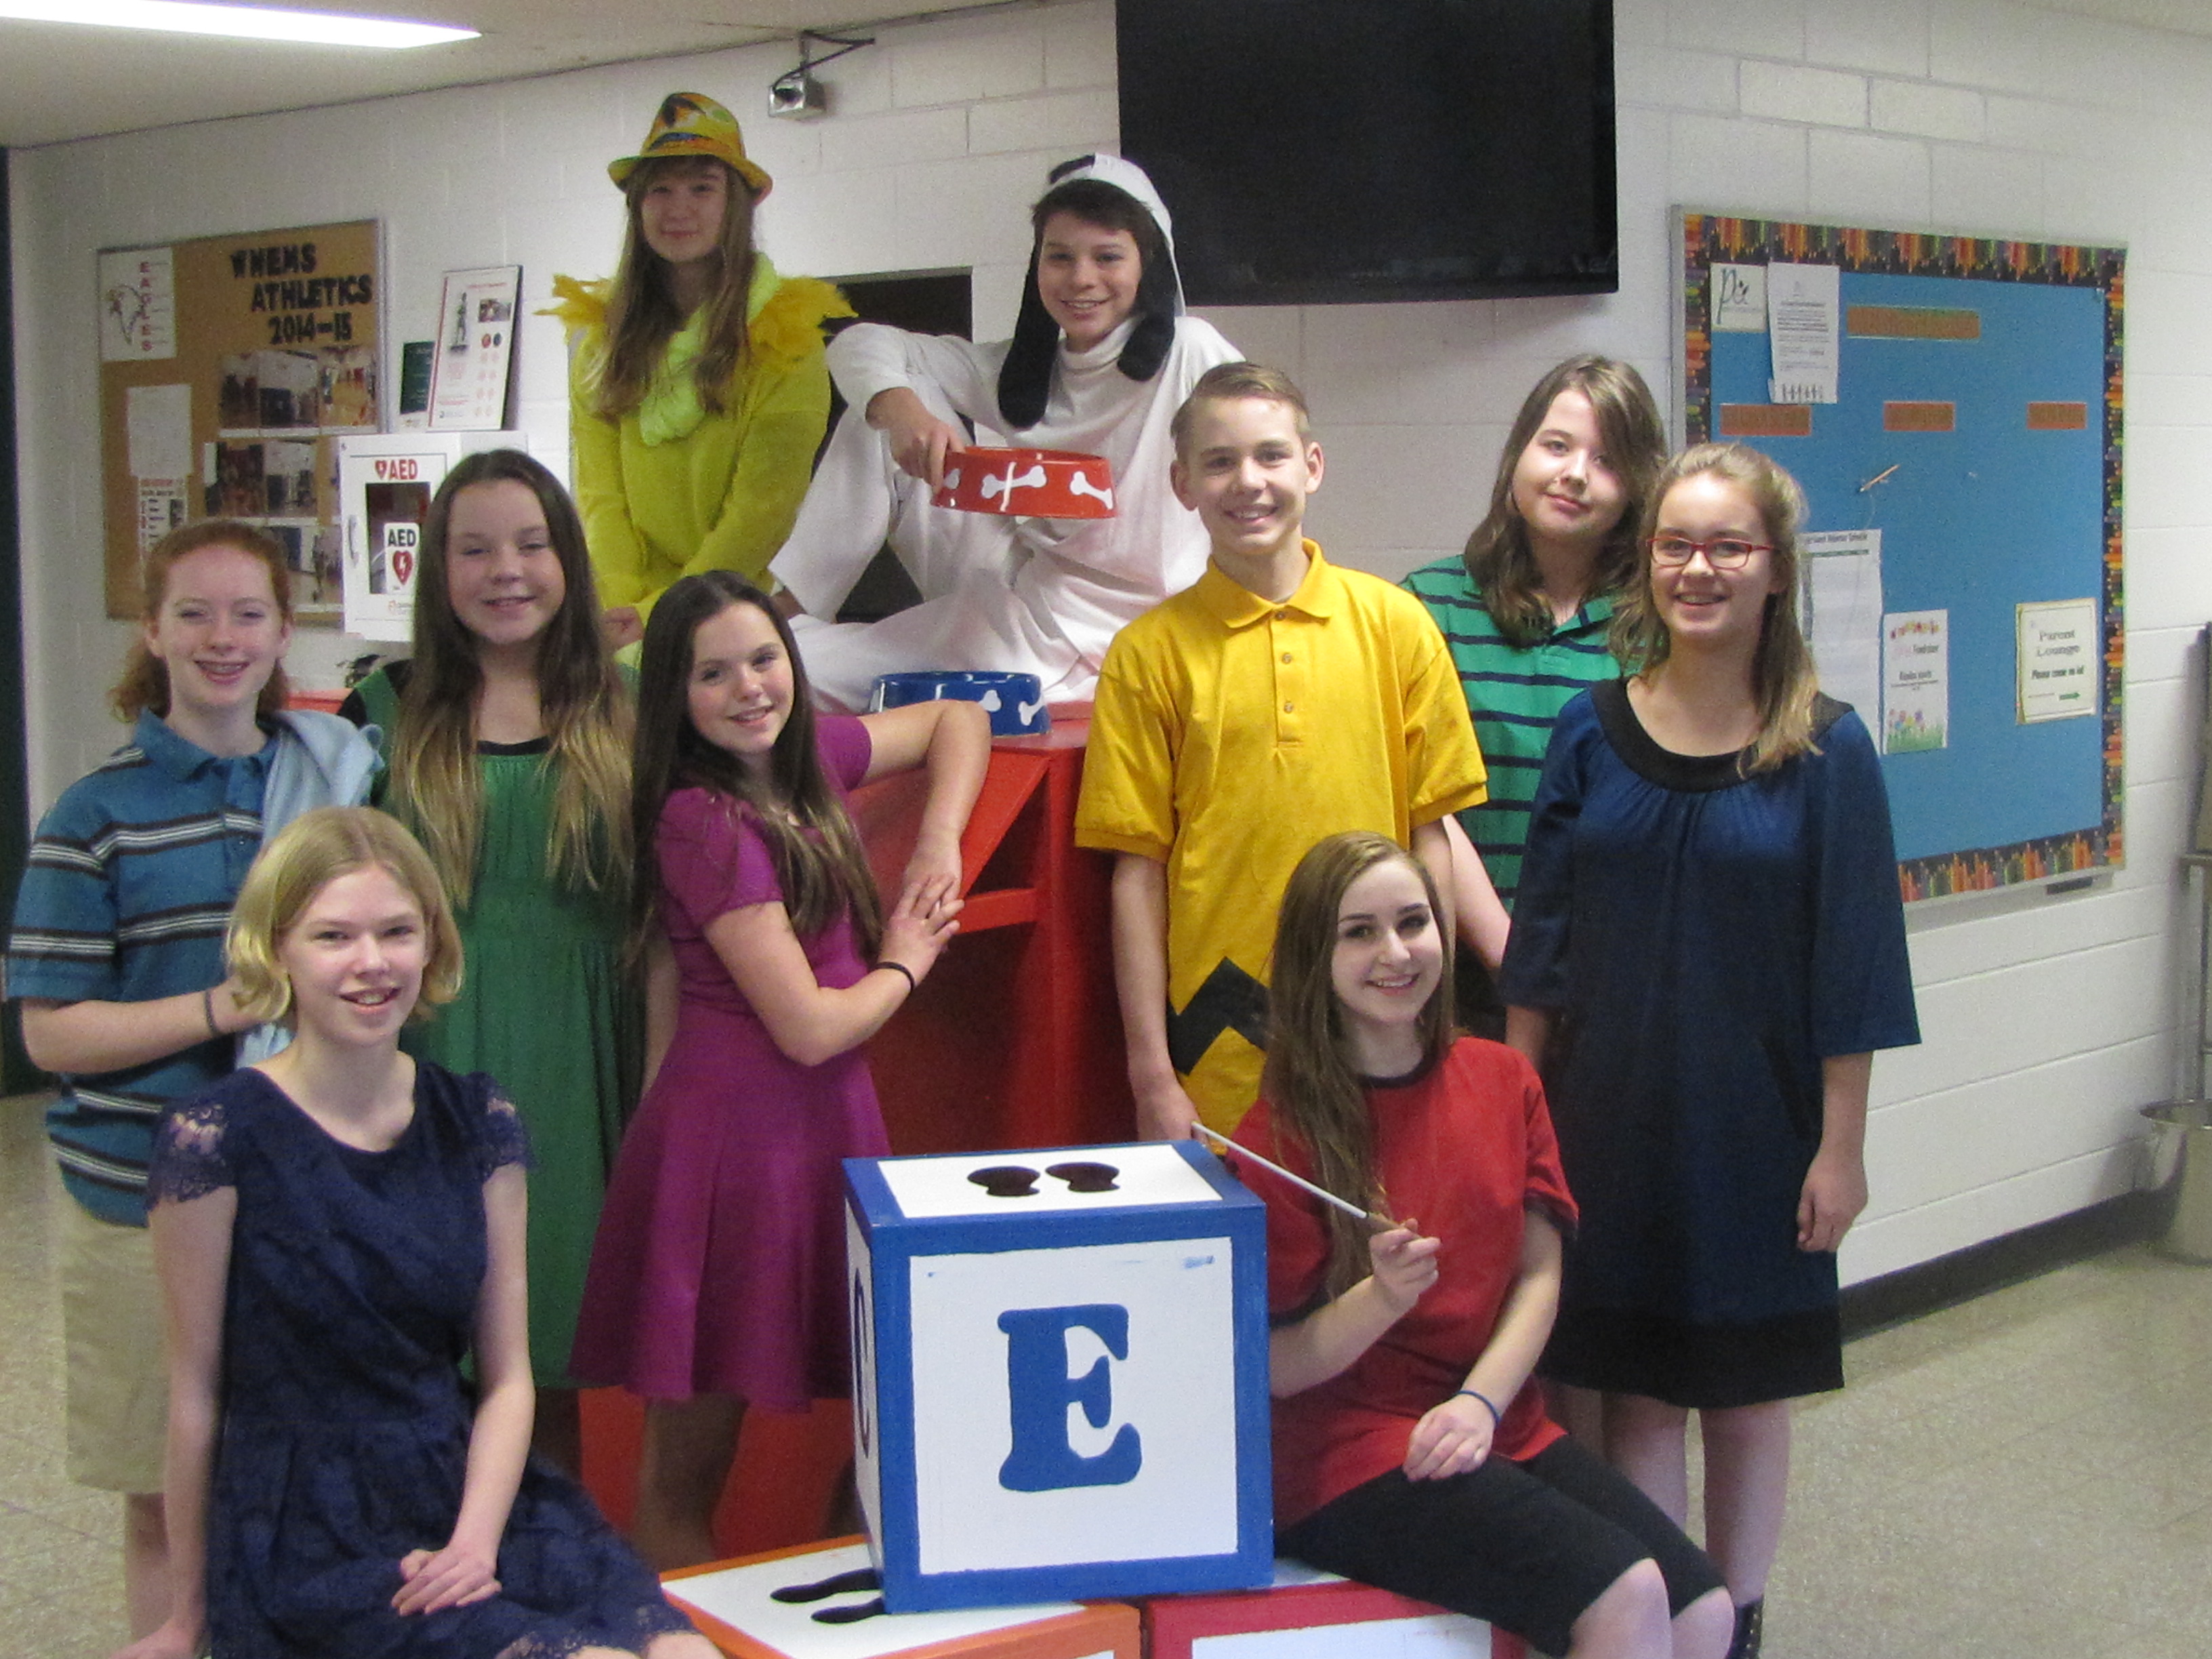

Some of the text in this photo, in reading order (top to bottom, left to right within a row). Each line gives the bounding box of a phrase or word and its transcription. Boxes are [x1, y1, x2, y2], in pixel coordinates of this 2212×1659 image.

[251, 274, 372, 312] ATHLETICS
[388, 459, 418, 480] AED
[387, 529, 416, 547] AED
[2036, 645, 2081, 657] Lounge
[998, 1304, 1142, 1492] E
